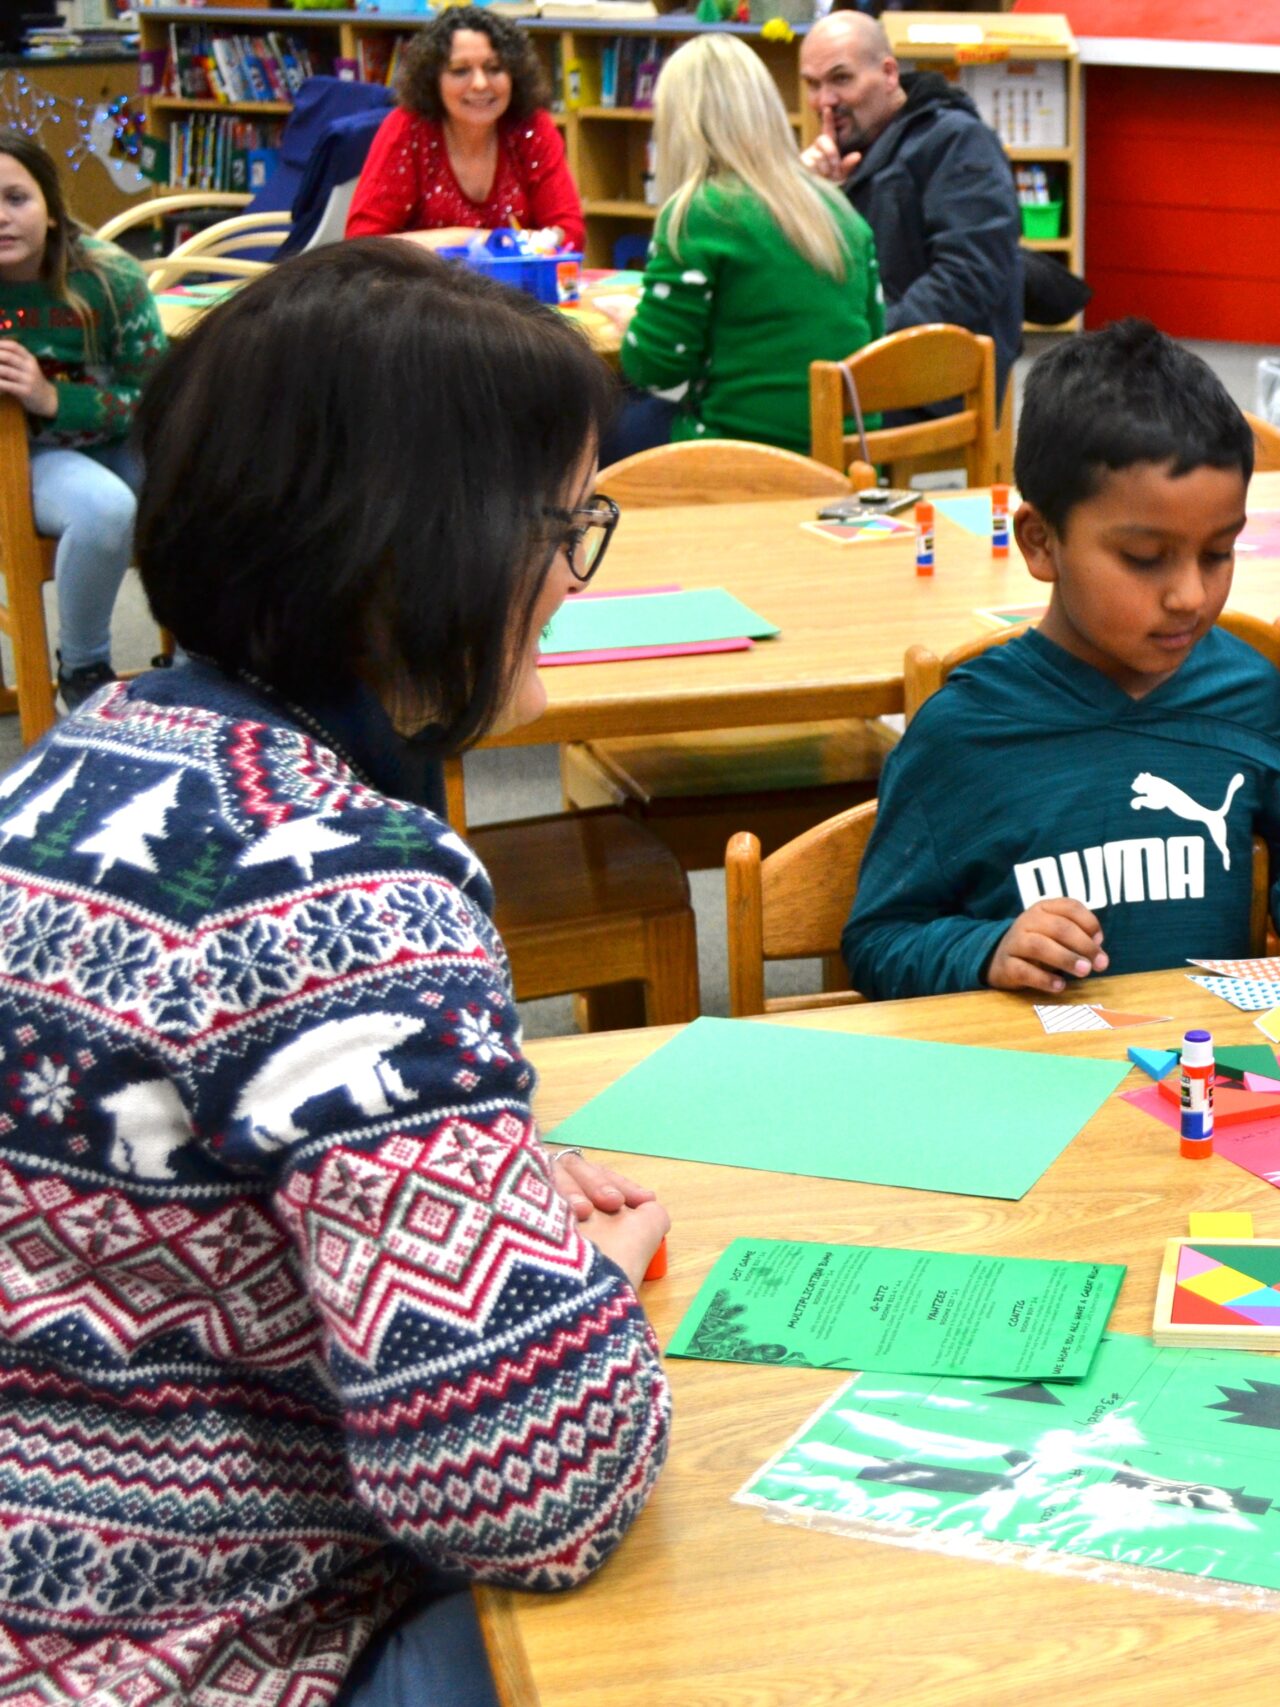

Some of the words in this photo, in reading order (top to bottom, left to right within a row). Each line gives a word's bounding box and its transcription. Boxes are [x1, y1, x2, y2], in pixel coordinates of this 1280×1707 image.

[1014, 836, 1205, 911] PUMA
[787, 1267, 825, 1329] MULTIPLICATION
[927, 1289, 949, 1321] YAHTZEE
[1008, 1299, 1027, 1327] CONTIG
[1069, 1320, 1080, 1333] ALL
[1056, 1344, 1071, 1363] HOPE
[1053, 1362, 1065, 1375] WE
